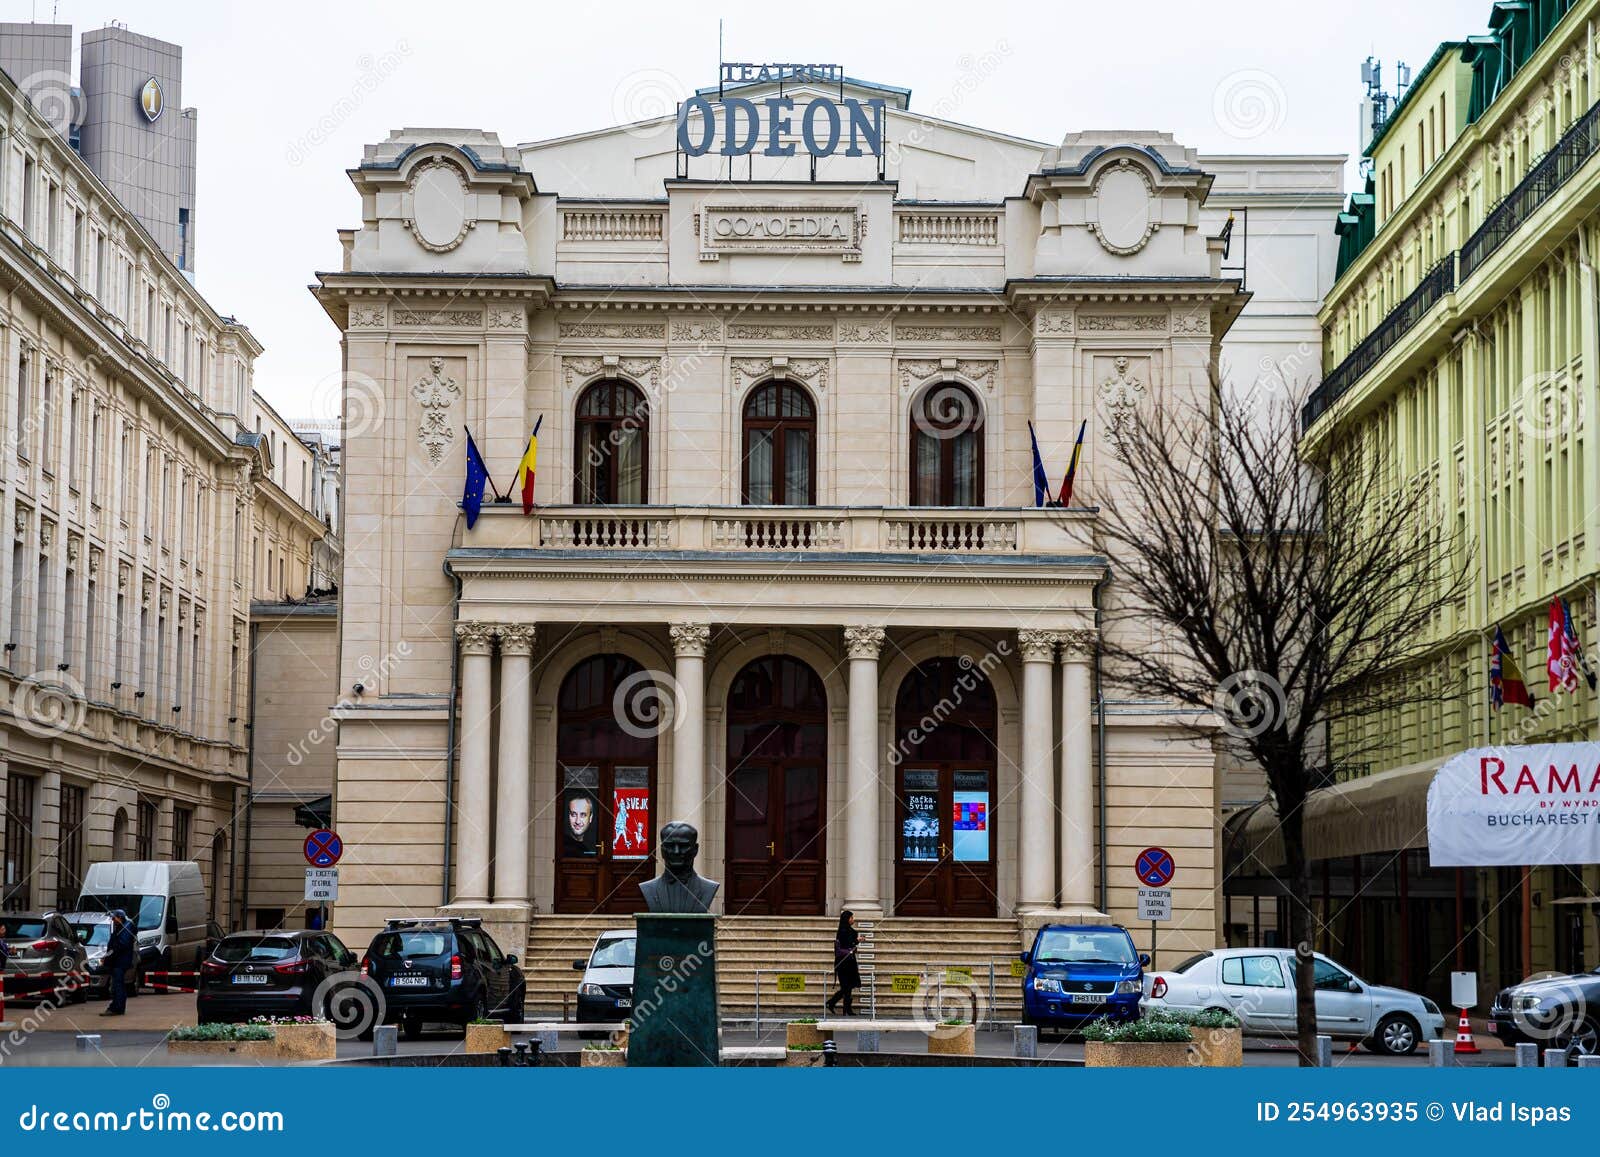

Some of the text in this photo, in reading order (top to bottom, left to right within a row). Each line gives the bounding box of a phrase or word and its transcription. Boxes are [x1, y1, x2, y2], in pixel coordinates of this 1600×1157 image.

[721, 63, 843, 82] TEATRUL
[677, 97, 886, 158] ODEON
[715, 218, 846, 237] COMOEDIA
[1487, 813, 1589, 827] BUCHAREST
